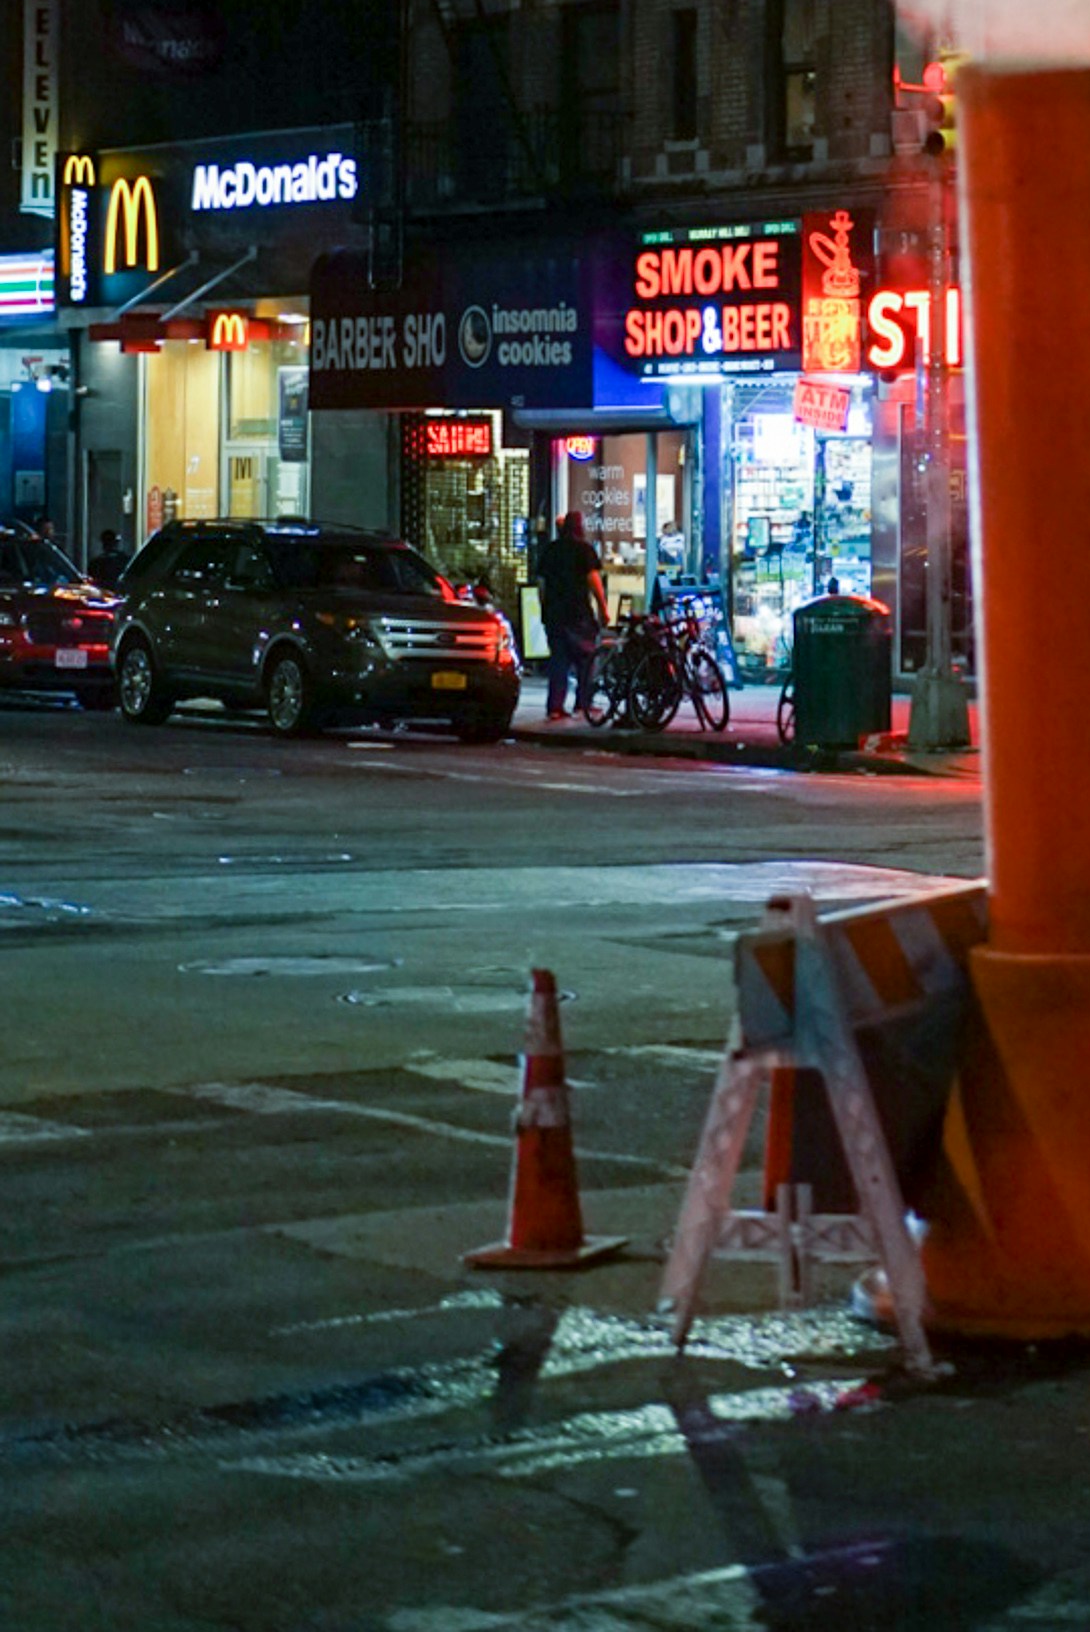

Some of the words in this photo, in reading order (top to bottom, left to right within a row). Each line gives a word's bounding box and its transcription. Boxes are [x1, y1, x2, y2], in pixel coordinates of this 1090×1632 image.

[191, 153, 358, 211] McDonald's
[70, 189, 87, 301] McDonald's
[635, 241, 779, 299] SMOKE
[492, 302, 578, 334] insomnia
[313, 316, 397, 369] BARBER
[498, 335, 573, 366] cookies
[801, 387, 848, 411] ATM
[588, 465, 625, 481] warm
[581, 487, 630, 506] cookies
